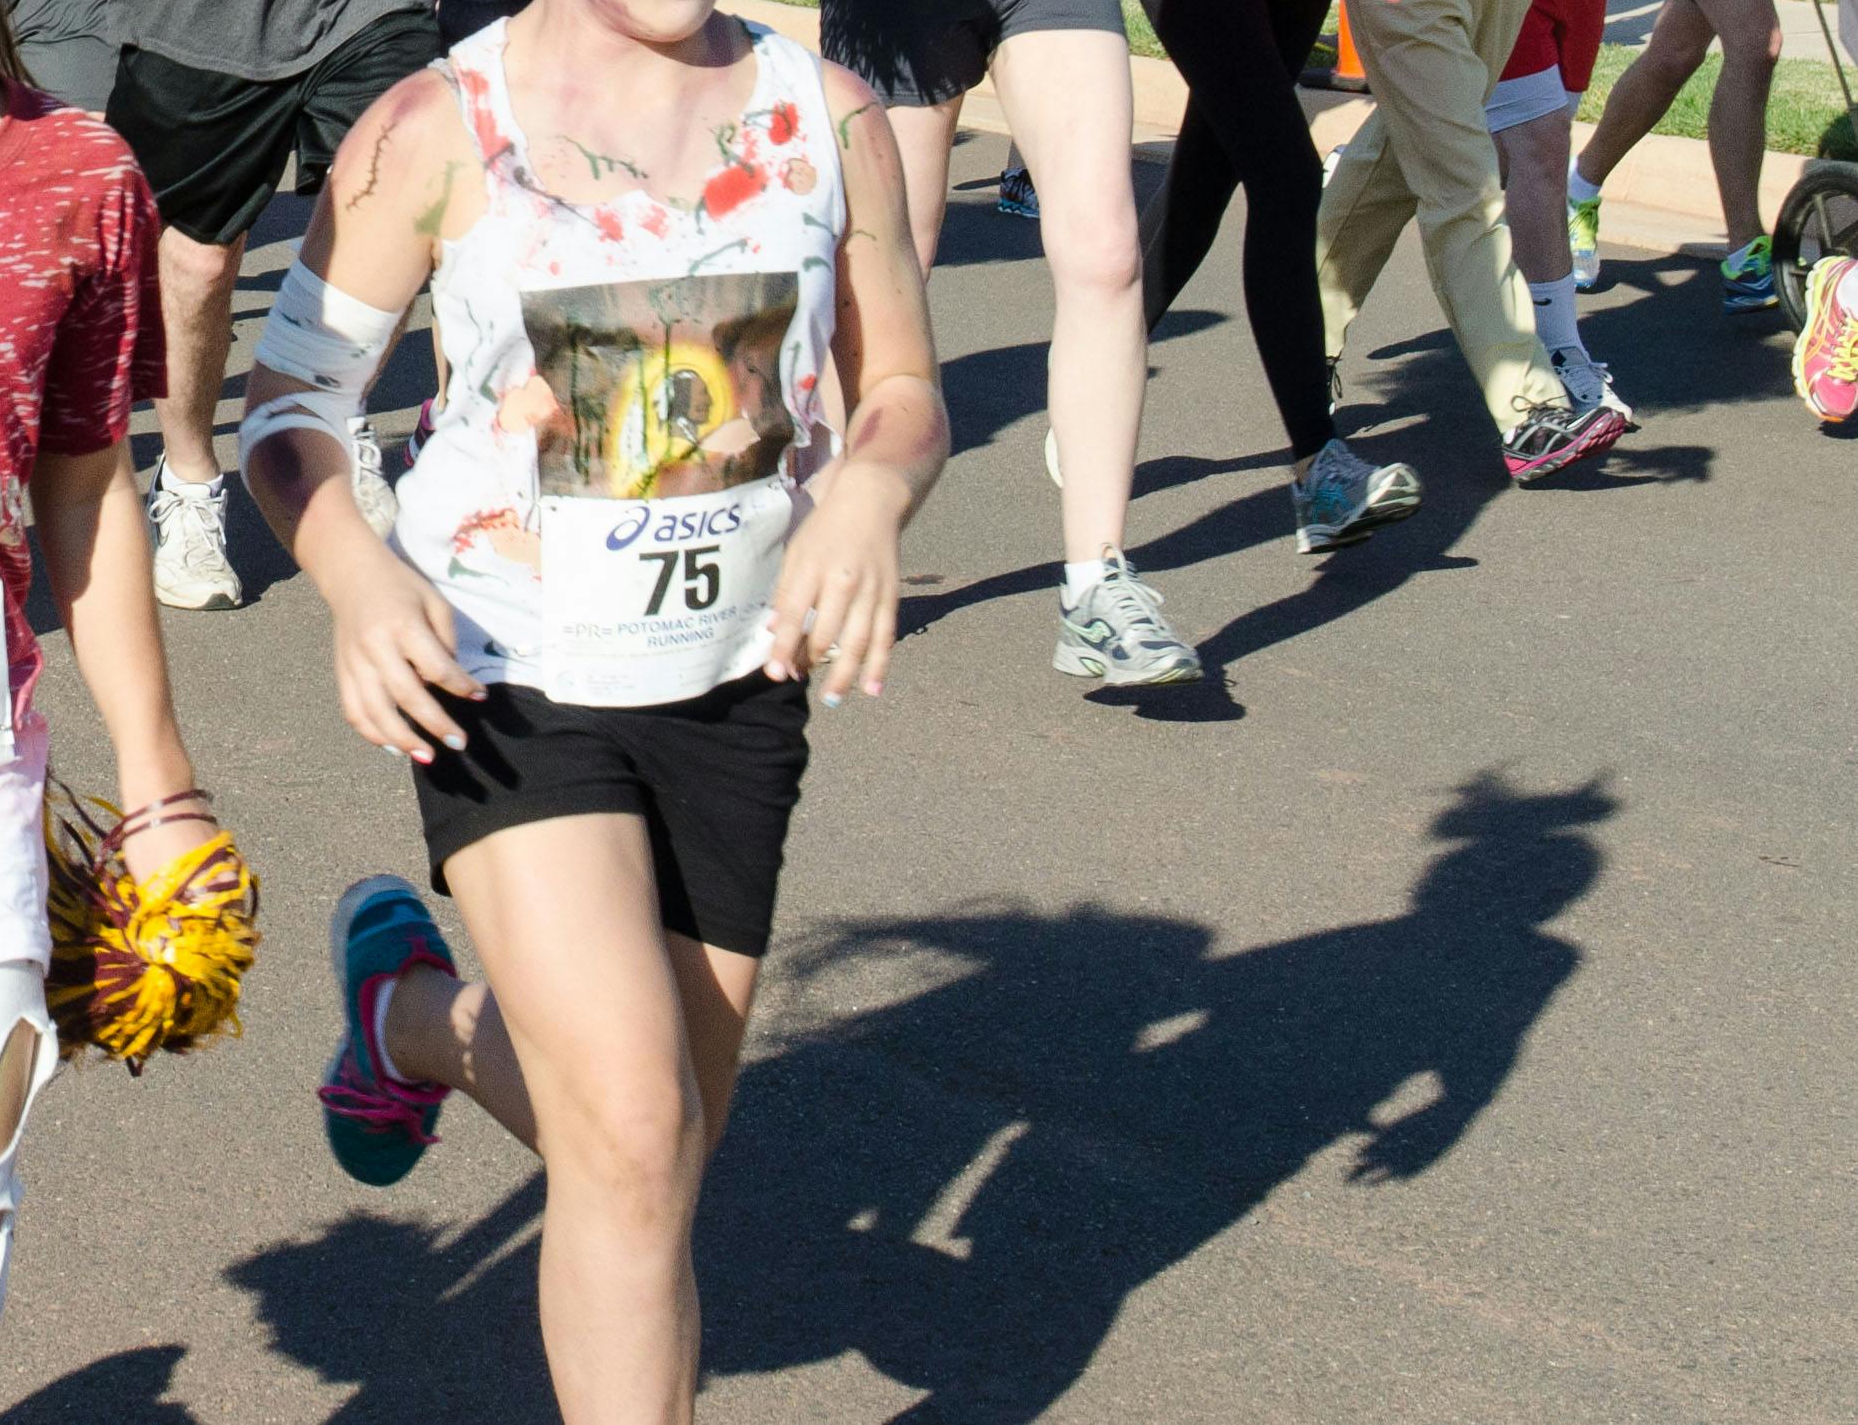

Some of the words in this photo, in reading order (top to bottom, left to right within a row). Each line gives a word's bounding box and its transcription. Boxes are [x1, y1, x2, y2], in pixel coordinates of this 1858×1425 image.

[654, 504, 742, 542] asics
[639, 544, 721, 617] 75
[618, 616, 695, 634] POTOMAC
[698, 605, 737, 626] RIVER
[647, 627, 715, 648] RUNNING
